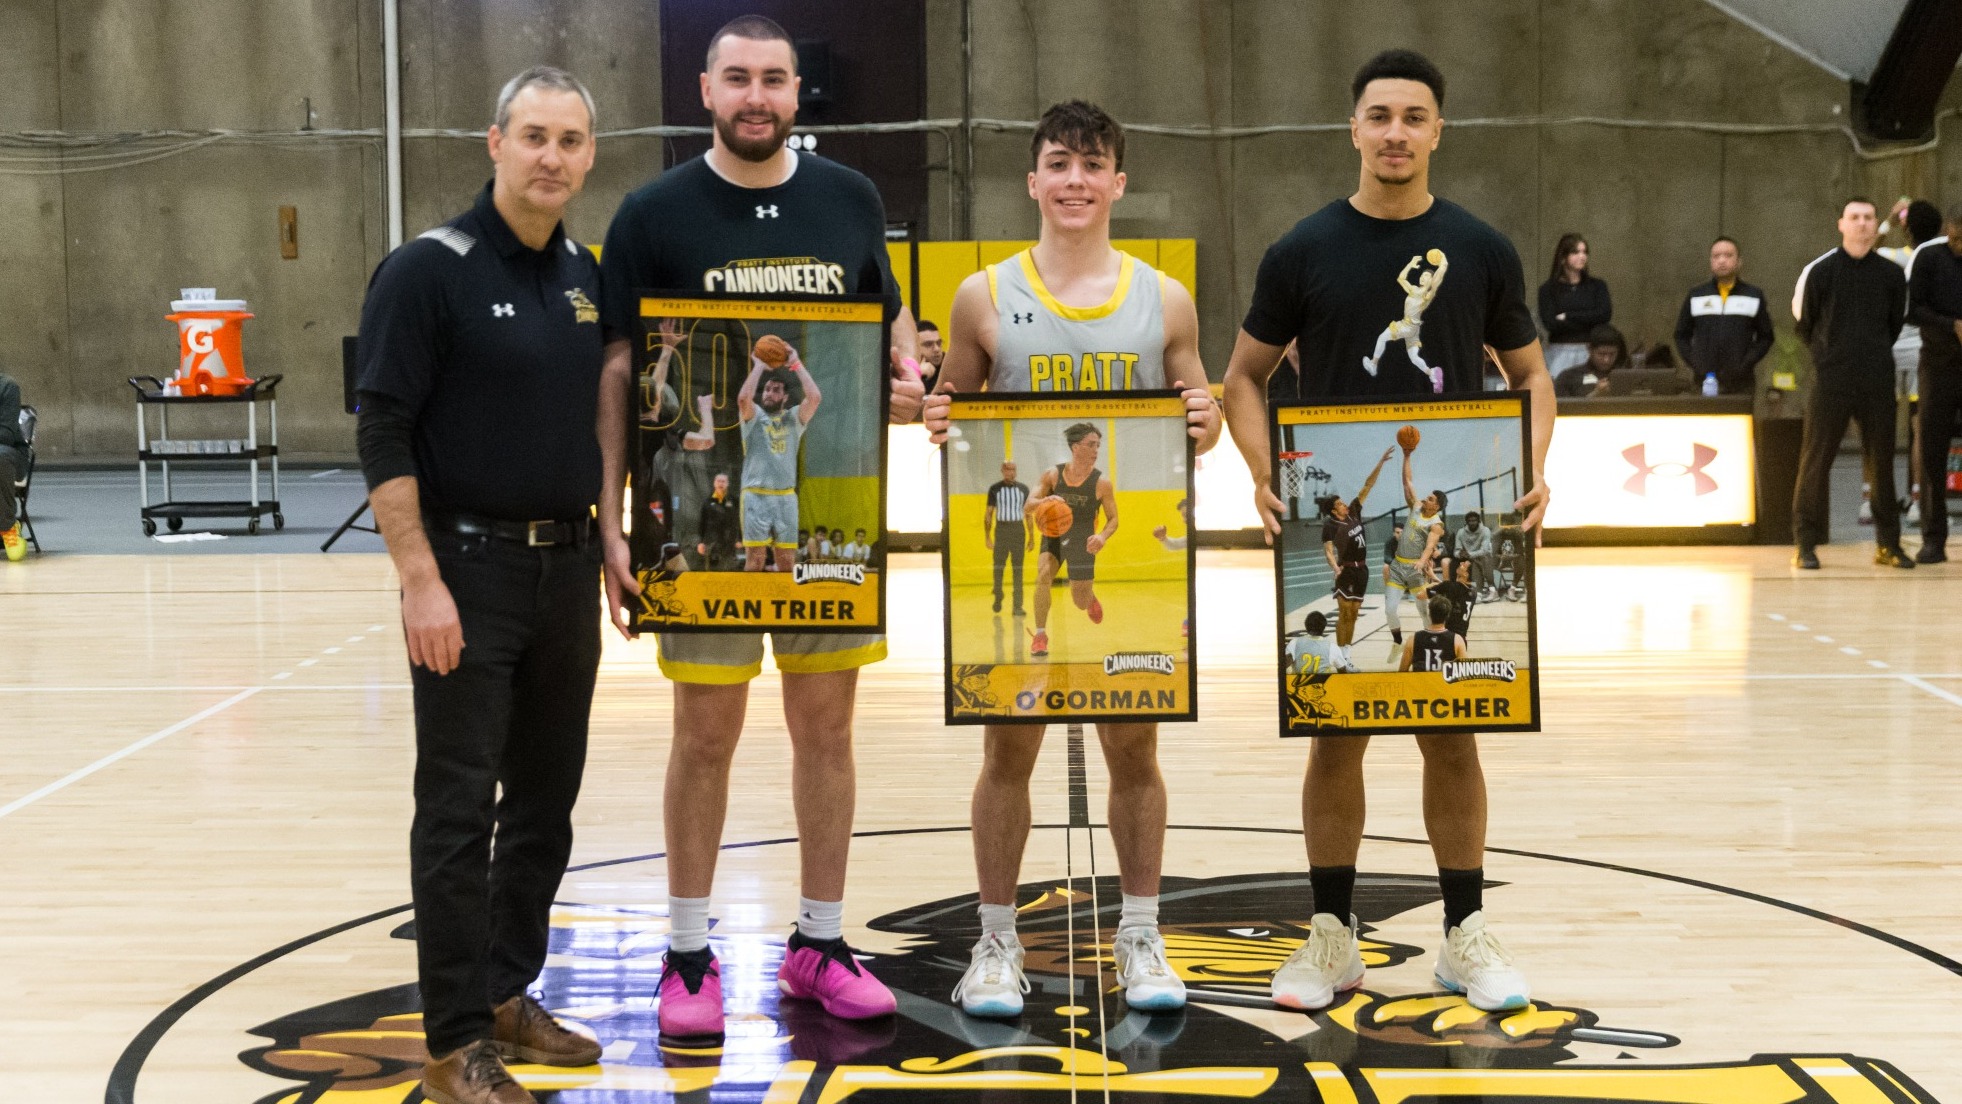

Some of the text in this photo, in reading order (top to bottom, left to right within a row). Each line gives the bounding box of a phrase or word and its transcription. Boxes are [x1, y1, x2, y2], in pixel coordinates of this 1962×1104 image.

[704, 264, 845, 294] CANNONEERS
[662, 302, 693, 310] PRATT
[697, 303, 751, 312] INSTITUTE
[790, 305, 854, 314] BASKETBALL
[187, 322, 214, 354] G
[1029, 352, 1140, 392] PRATT
[1003, 404, 1056, 412] INSTITUTE
[1095, 403, 1159, 411] BASKETBALL
[1335, 407, 1388, 415] INSTITUTE
[1393, 405, 1425, 413] MEN'S
[1429, 404, 1494, 412] BASKETBALL
[793, 563, 865, 585] CANNONEERS
[702, 599, 855, 621] VAN TRIER
[1104, 654, 1175, 674] CANNONEERS
[1301, 653, 1321, 674] 21
[1424, 649, 1443, 672] 13
[1443, 660, 1517, 682] CANNONEERS
[1016, 689, 1175, 711] O'GORMAN
[1353, 697, 1511, 720] BRATCHER
